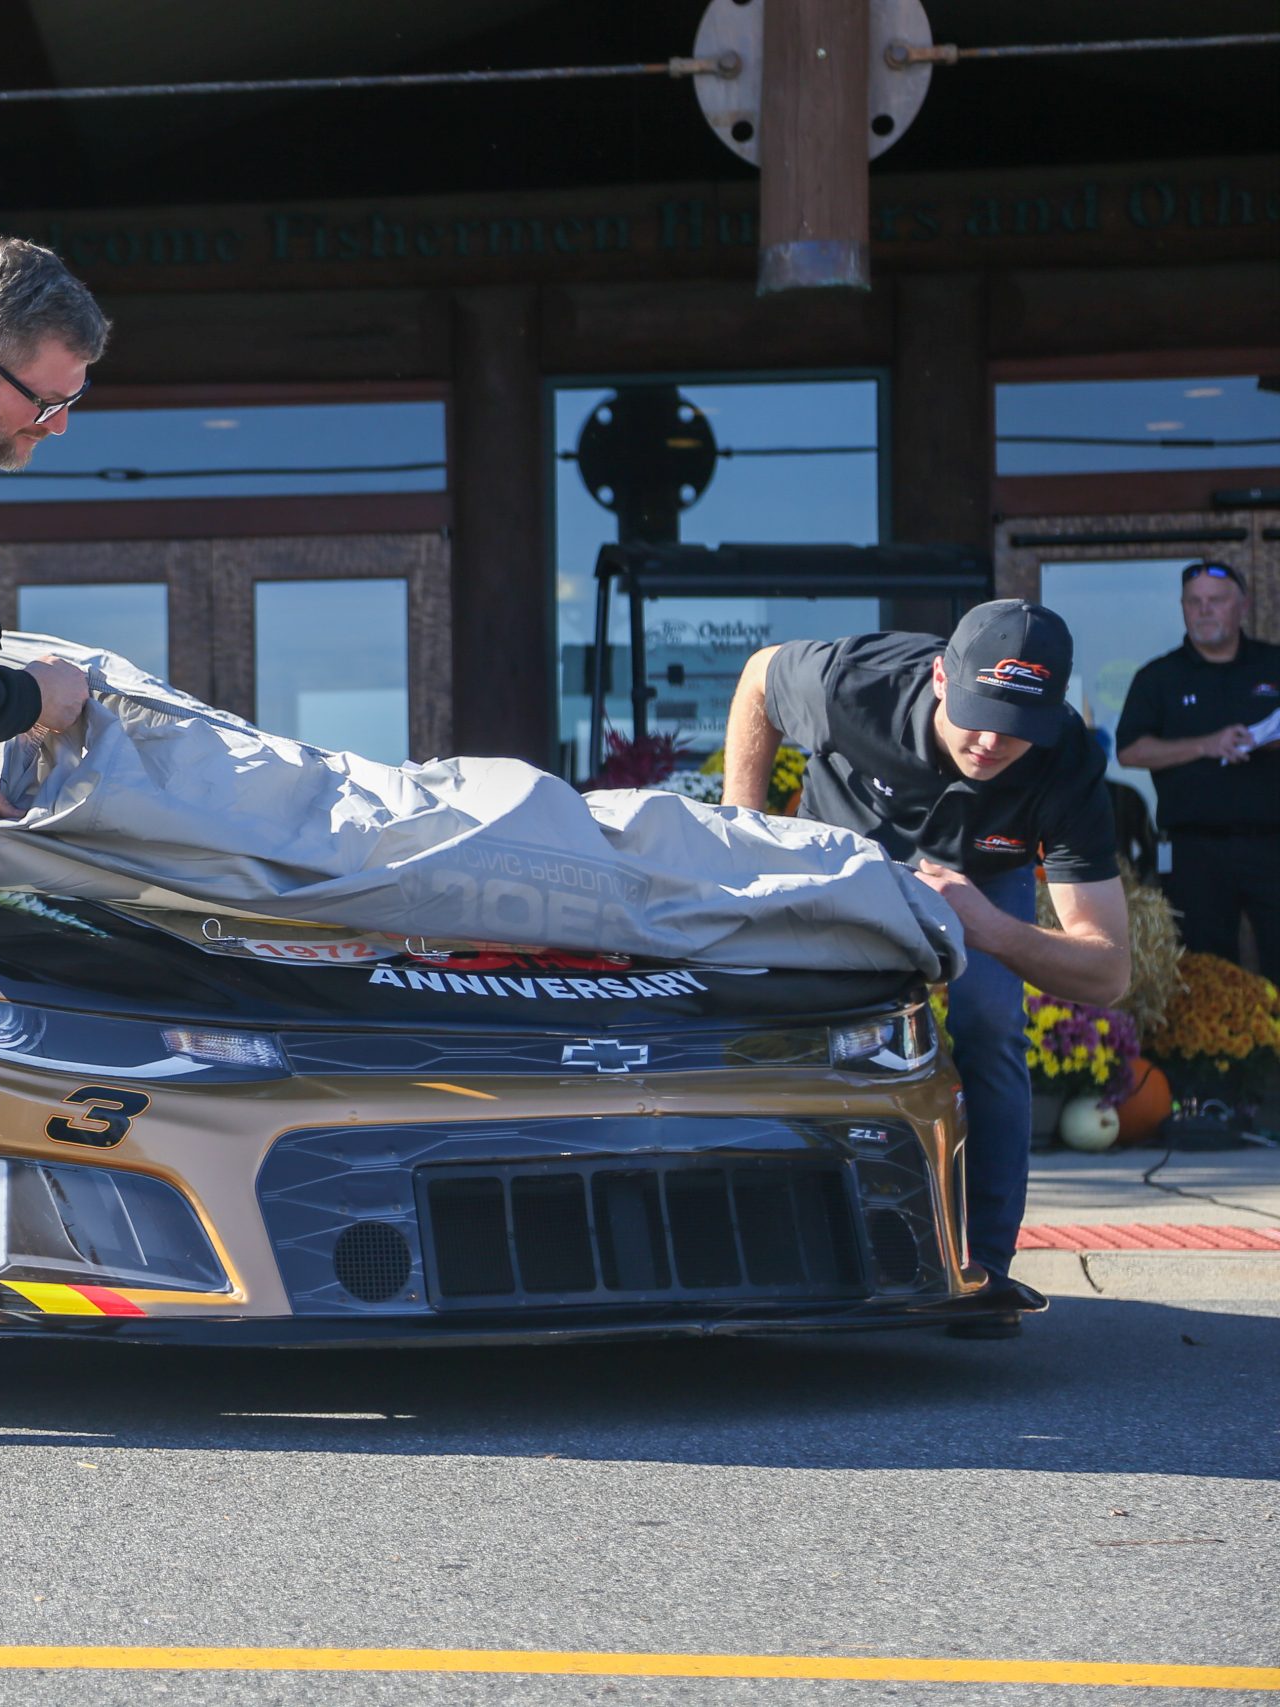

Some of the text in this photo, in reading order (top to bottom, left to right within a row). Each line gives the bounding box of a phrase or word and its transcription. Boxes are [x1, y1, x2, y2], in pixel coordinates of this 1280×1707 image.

[264, 208, 634, 262] Fishermen
[656, 198, 942, 252] Hurs
[965, 180, 1099, 237] and
[699, 620, 772, 639] Outdoor
[254, 942, 376, 959] 1972
[368, 963, 709, 999] ANNIVERSARY
[44, 1084, 151, 1149] 3
